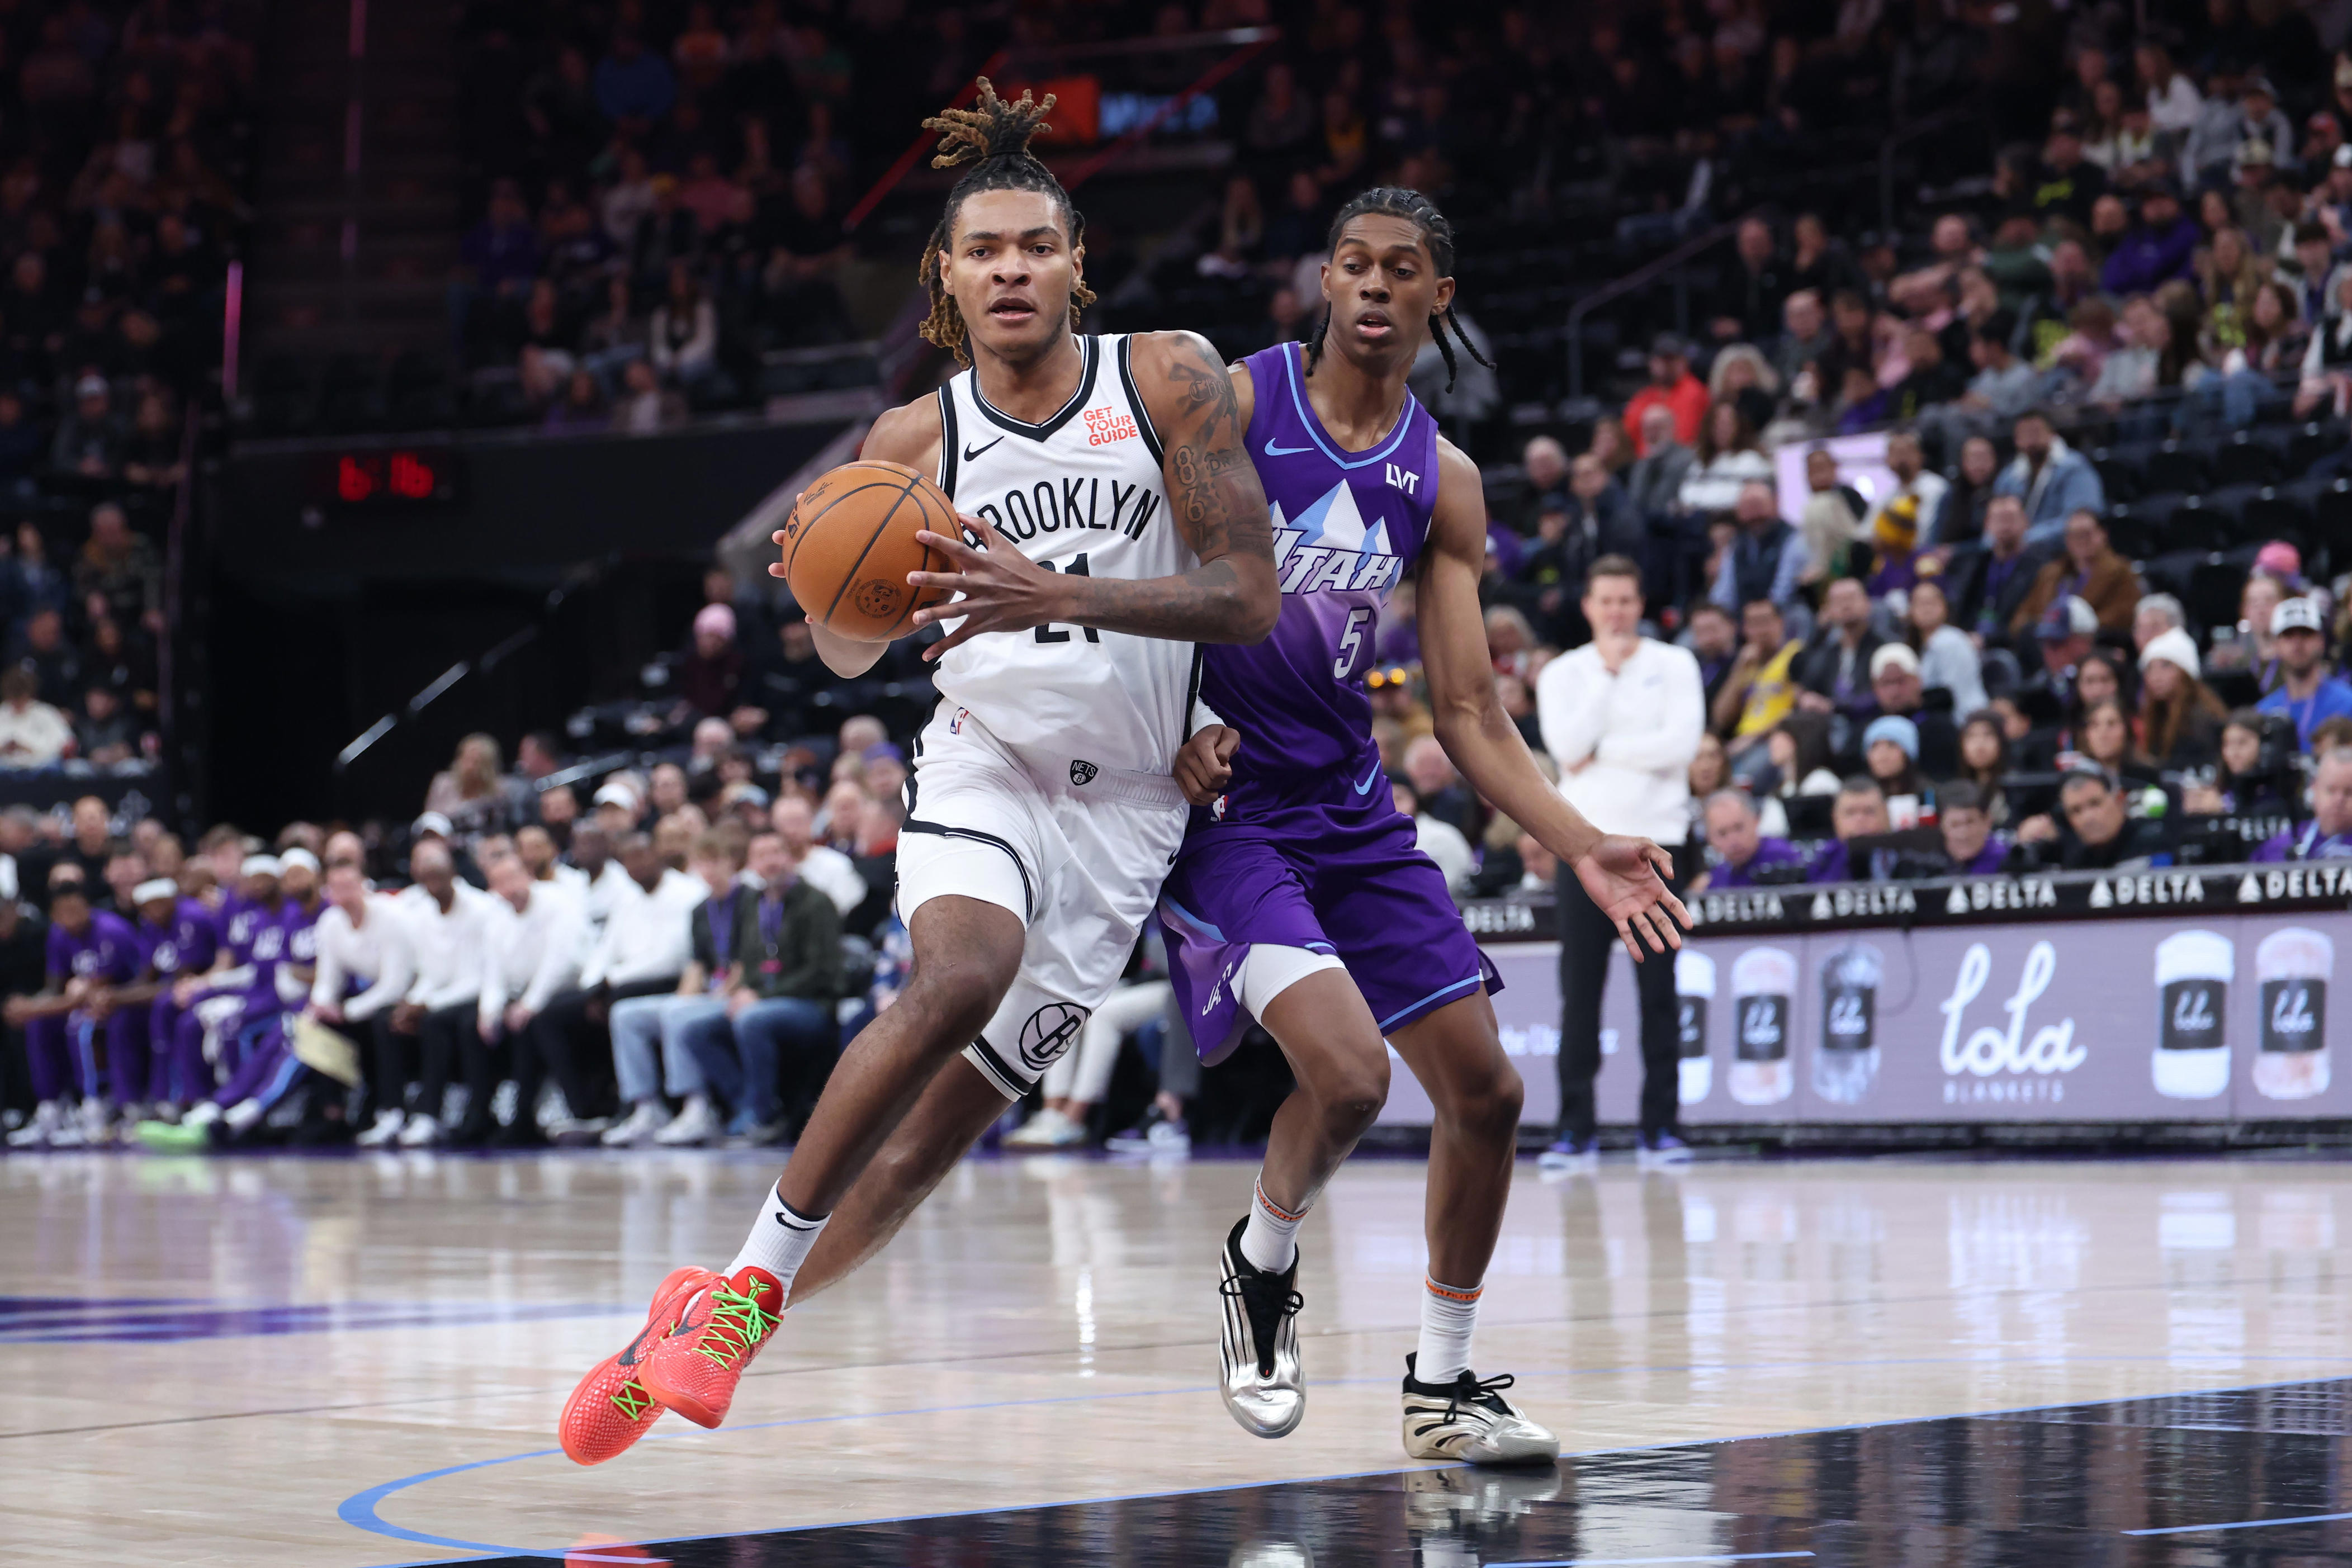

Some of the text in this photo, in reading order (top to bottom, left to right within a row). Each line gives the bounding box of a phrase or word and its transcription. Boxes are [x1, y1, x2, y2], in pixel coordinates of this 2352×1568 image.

[1083, 406, 1113, 421] GET
[1085, 415, 1132, 433] YOUR
[1089, 425, 1138, 447] GUIDE
[1385, 462, 1420, 495] LVT
[1333, 607, 1374, 679] 5
[1071, 761, 1096, 777] NETS
[1971, 878, 2057, 911] DELTA
[2116, 873, 2205, 905] DELTA
[2265, 867, 2352, 899] DELTA
[1706, 892, 1785, 923] DELTA
[1834, 885, 1917, 917] DELTA
[1939, 940, 2089, 1078] lola
